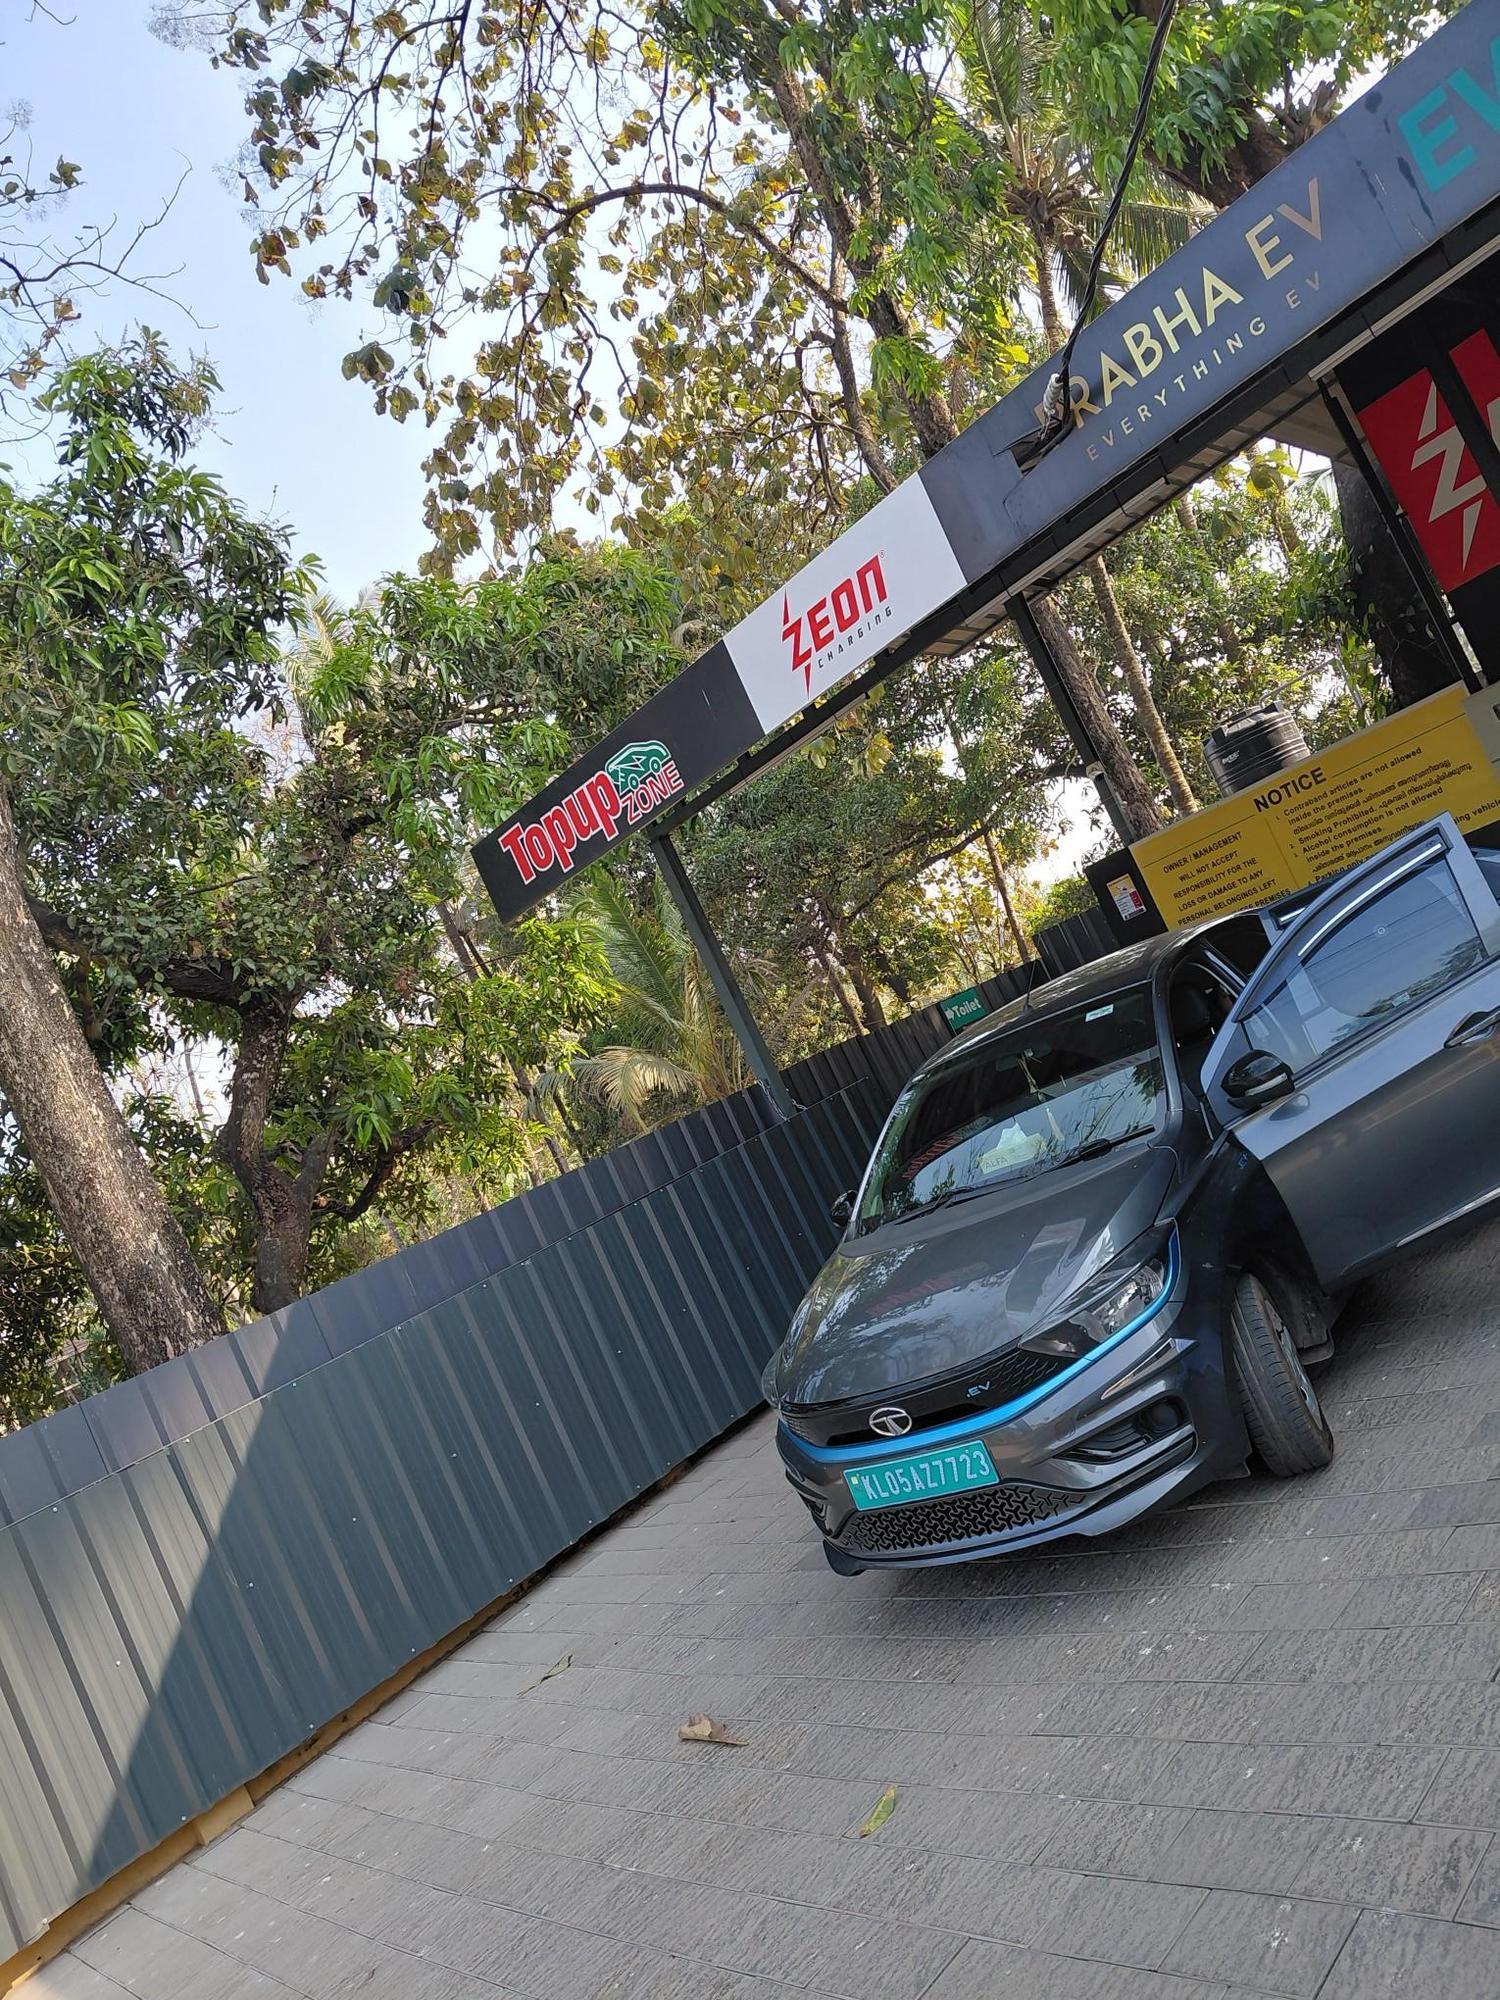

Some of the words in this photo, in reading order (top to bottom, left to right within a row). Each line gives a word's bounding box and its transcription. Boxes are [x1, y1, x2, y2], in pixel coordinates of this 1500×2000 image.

[1245, 177, 1324, 281] EV
[1085, 316, 1267, 462] EVERYTHING
[1285, 272, 1322, 310] EV
[817, 606, 893, 669] CHARGING
[621, 759, 686, 827] ZONE
[1253, 767, 1327, 813] NOTICE
[1283, 791, 1328, 817] Contraband
[1329, 778, 1359, 795] articles
[1360, 771, 1373, 781] are
[1374, 763, 1389, 774] not
[1390, 747, 1422, 767] allowed
[499, 770, 627, 885] Topup
[1298, 826, 1333, 844] Smoking
[1332, 806, 1377, 829] Prohibited.
[1303, 836, 1332, 854] Alcohol
[1333, 814, 1385, 840] consumption
[1395, 802, 1410, 813] not
[1411, 786, 1444, 806] allowed
[1312, 805, 1326, 814] the
[1472, 799, 1500, 816] vehicl
[1163, 857, 1189, 874] OWNER
[1192, 831, 1242, 860] MANAGEMENT
[1178, 871, 1196, 882] WILL
[1195, 863, 1210, 875] NOT
[1211, 850, 1238, 868] ACCEPT
[1331, 843, 1344, 852] the
[1173, 870, 1226, 899] RESPONSIBILITY
[1226, 864, 1243, 876] FOR
[1242, 857, 1257, 868] THE
[1178, 899, 1197, 912] LOSS
[1196, 894, 1208, 904] OR
[1207, 881, 1238, 899] DAMAGE
[1237, 876, 1248, 886] TO
[1249, 869, 1263, 881] ANY
[1254, 888, 1291, 907] PREMISES
[1177, 907, 1214, 926] PERSONAL
[1213, 886, 1259, 911] BELONGINGS
[1258, 878, 1276, 892] LEFT
[952, 998, 981, 1017] Toilet
[863, 1451, 989, 1500] KL05AZ7723
